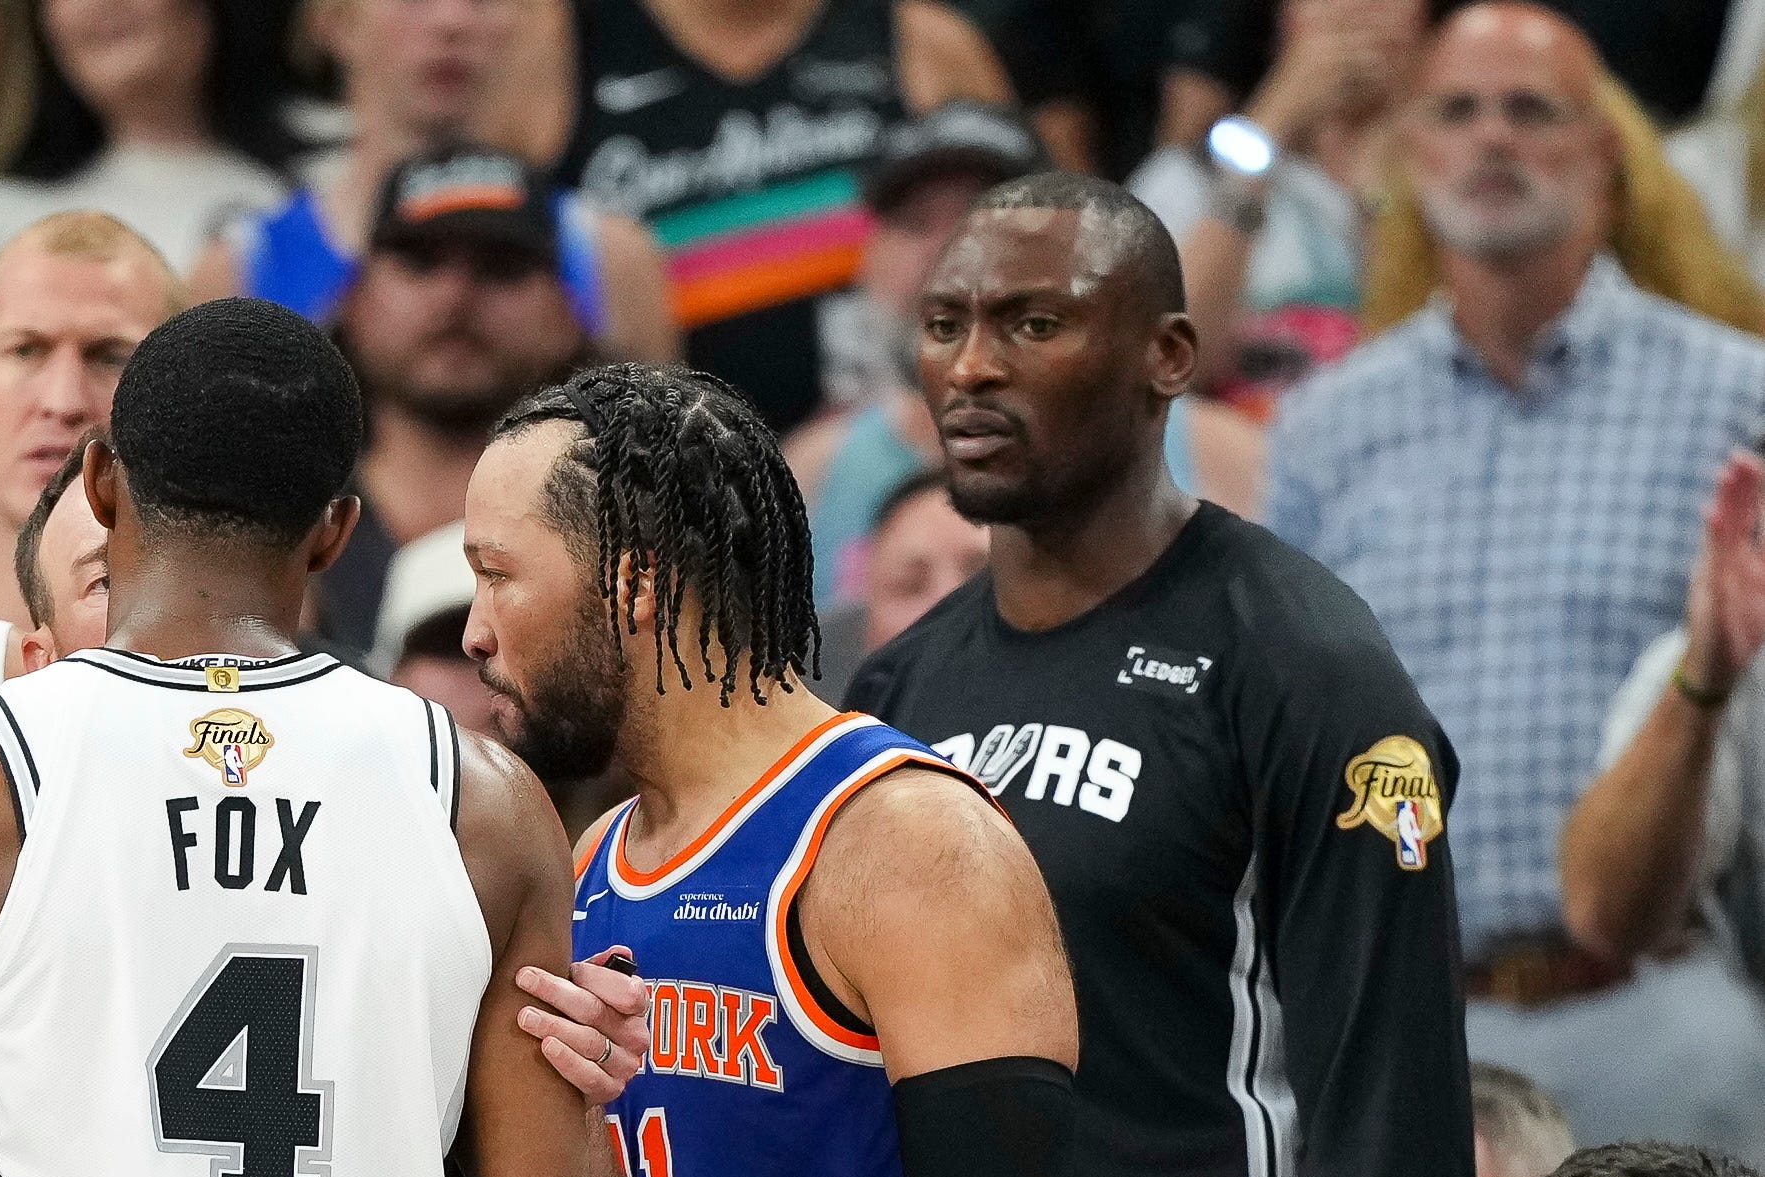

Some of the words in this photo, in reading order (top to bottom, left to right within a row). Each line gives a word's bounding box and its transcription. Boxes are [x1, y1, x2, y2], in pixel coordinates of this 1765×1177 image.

[188, 719, 270, 754] Finals
[165, 796, 322, 895] FOX
[673, 901, 707, 920] abu
[679, 891, 725, 903] experience
[635, 978, 785, 1092] ORK
